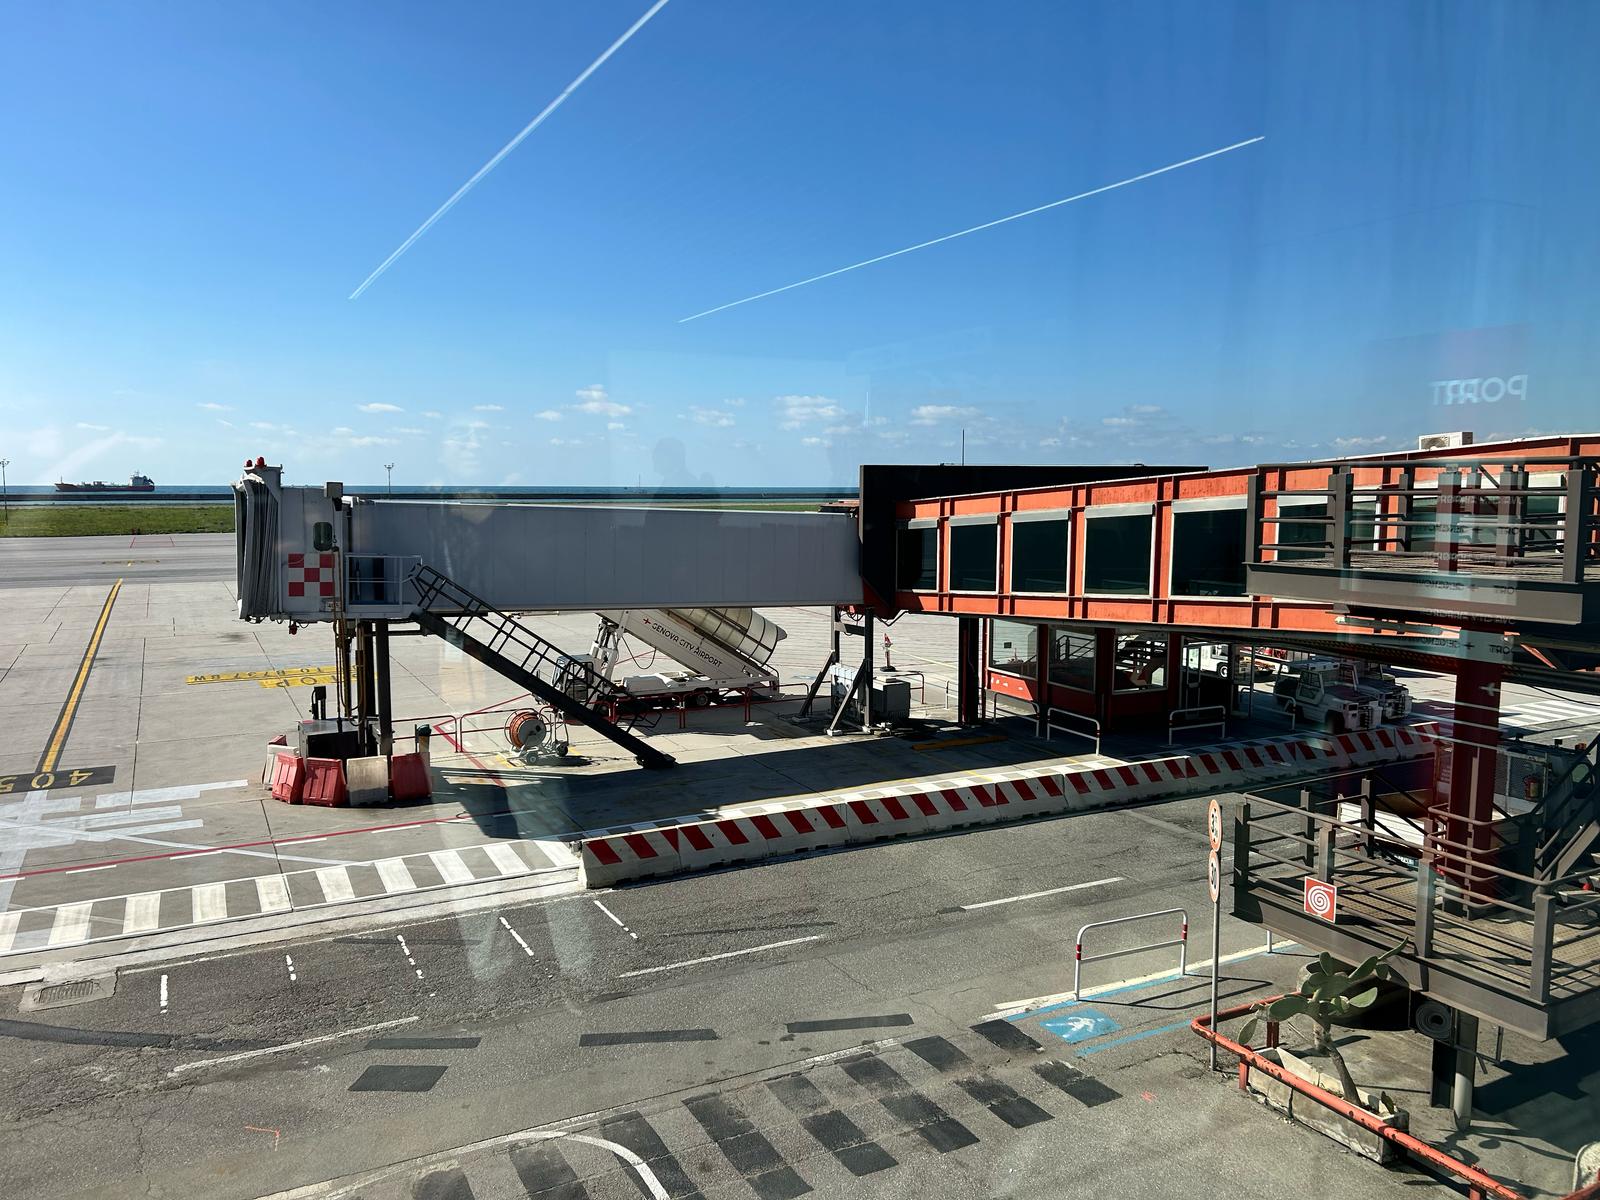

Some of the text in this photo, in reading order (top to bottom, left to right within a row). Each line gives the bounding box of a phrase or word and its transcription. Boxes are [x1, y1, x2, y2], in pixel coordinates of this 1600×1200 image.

[652, 622, 723, 667] GENOVA CITY AIRPORT
[0, 770, 93, 793] 405
